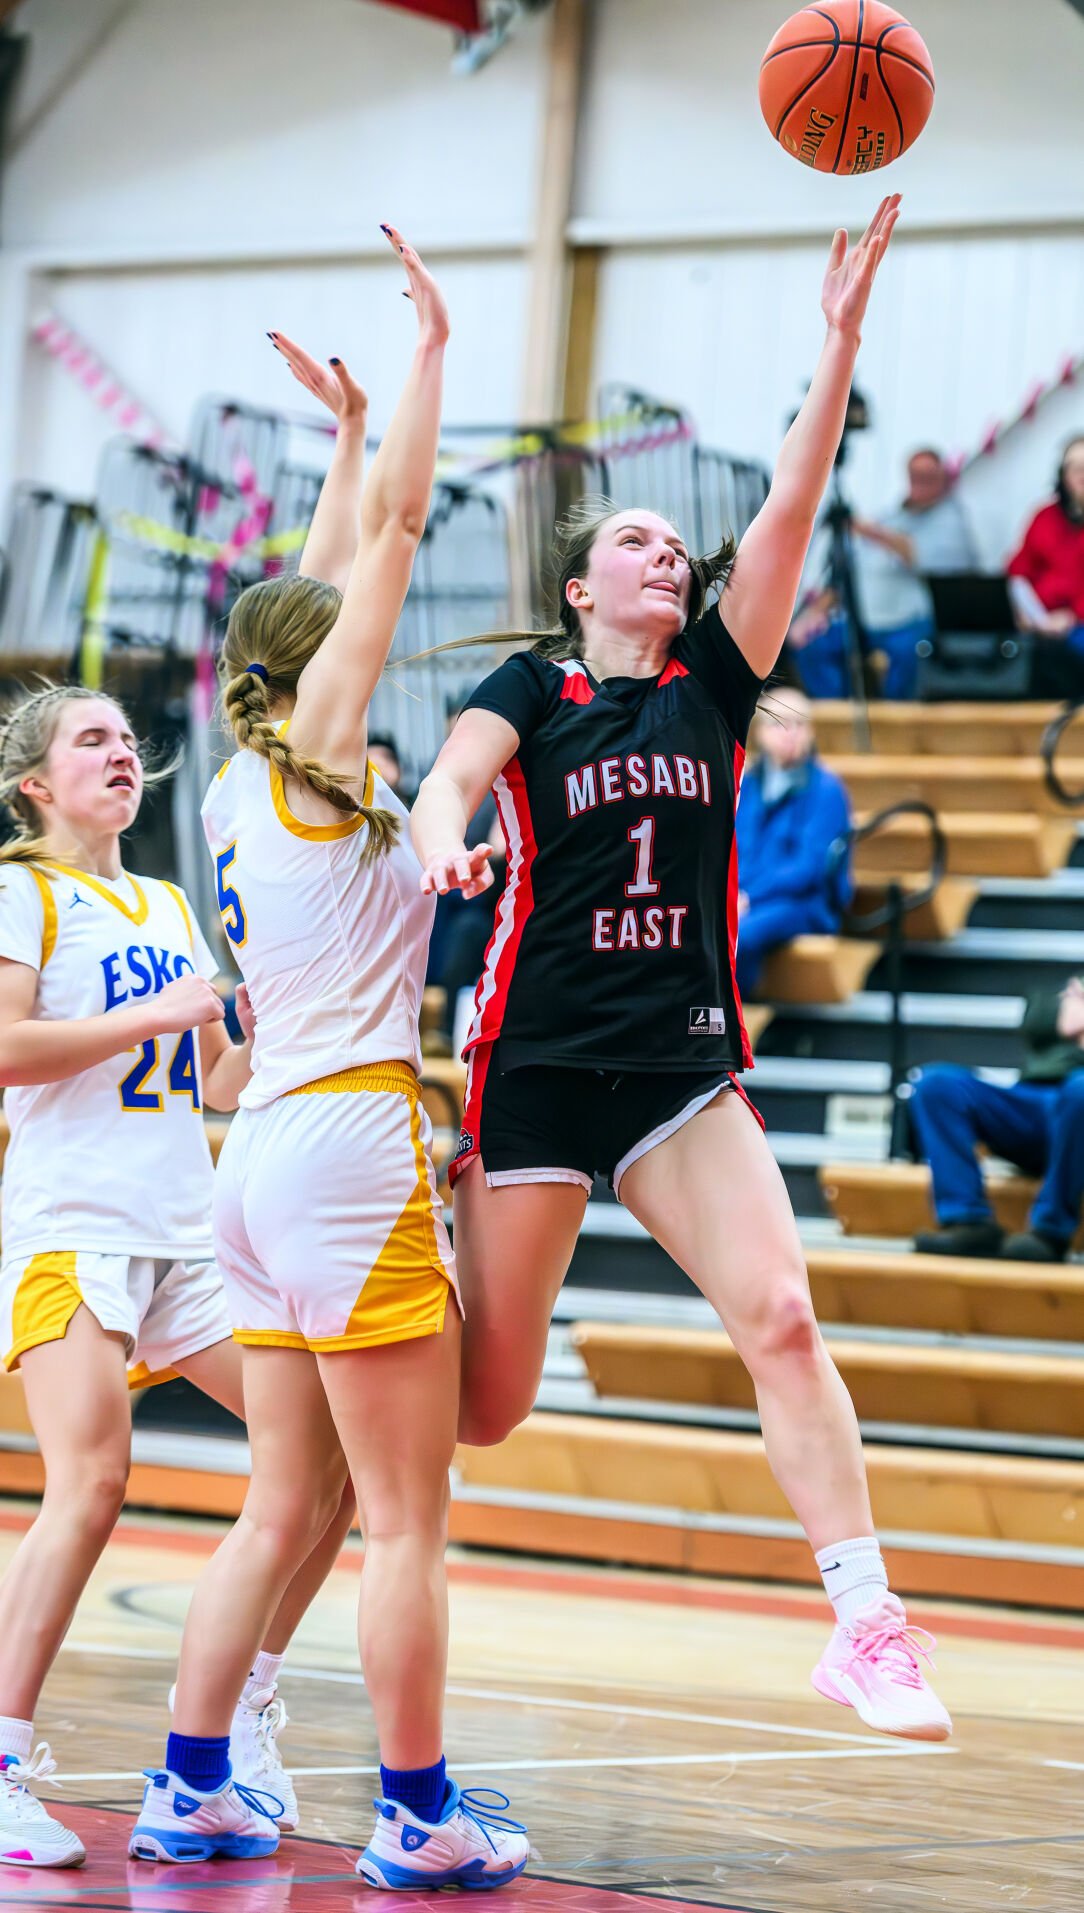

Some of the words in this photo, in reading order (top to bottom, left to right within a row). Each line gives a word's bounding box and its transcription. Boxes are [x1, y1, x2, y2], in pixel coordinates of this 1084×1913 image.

[565, 754, 711, 818] MESABI
[216, 839, 247, 949] 5
[625, 816, 660, 897] 1
[592, 906, 688, 951] EAST
[118, 1026, 202, 1112] 24
